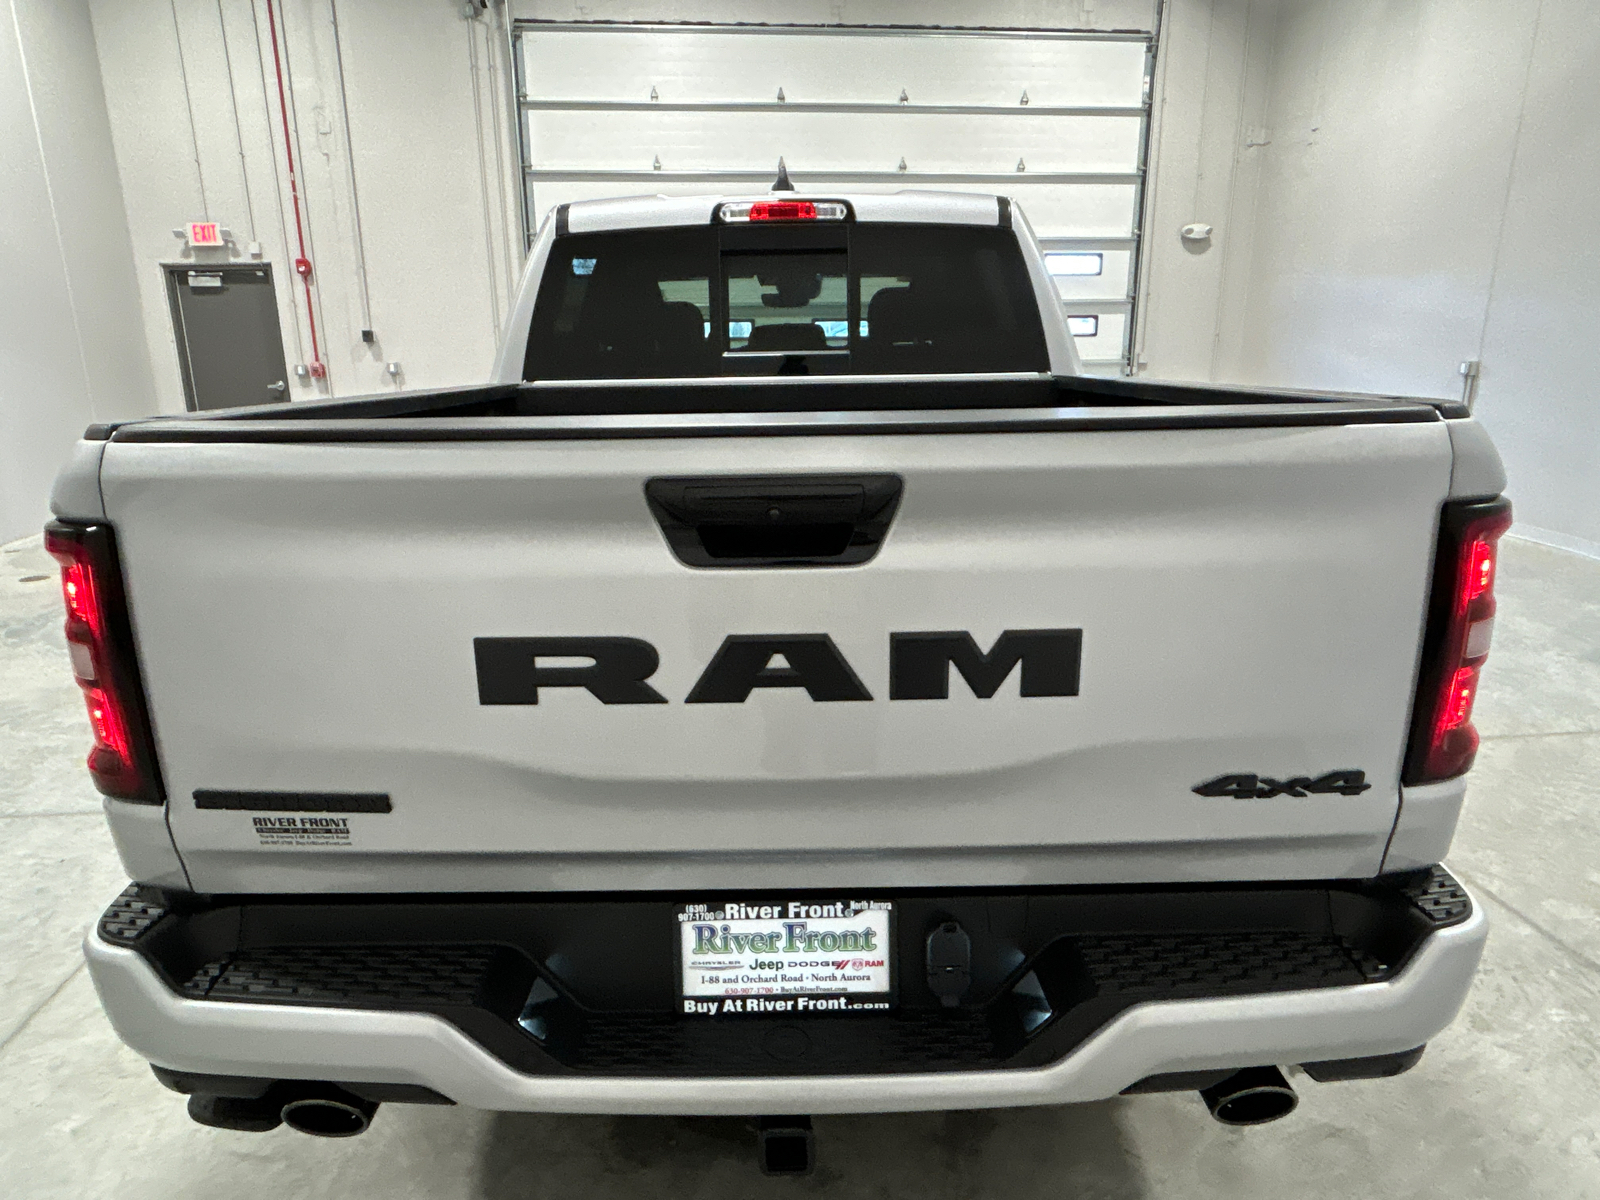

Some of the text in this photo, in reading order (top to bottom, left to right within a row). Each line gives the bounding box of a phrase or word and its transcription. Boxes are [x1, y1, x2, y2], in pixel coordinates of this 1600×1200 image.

[192, 224, 217, 243] EXIT
[473, 628, 1083, 706] RAM
[1191, 770, 1372, 799] 4x4
[252, 817, 348, 827] RIVER FRONT
[685, 904, 707, 913] (630)
[725, 902, 844, 919] River Front
[850, 900, 892, 910] North Aurora
[678, 912, 715, 921] 907-1700
[692, 921, 877, 954] River Front
[749, 958, 784, 971] Jeep
[788, 960, 840, 968] DODGE
[701, 973, 871, 984] I-88 and Orchard Road North Aurora
[724, 986, 774, 995] 630-907-1700
[683, 999, 718, 1015] Buy
[722, 998, 743, 1012] At
[746, 998, 794, 1012] River
